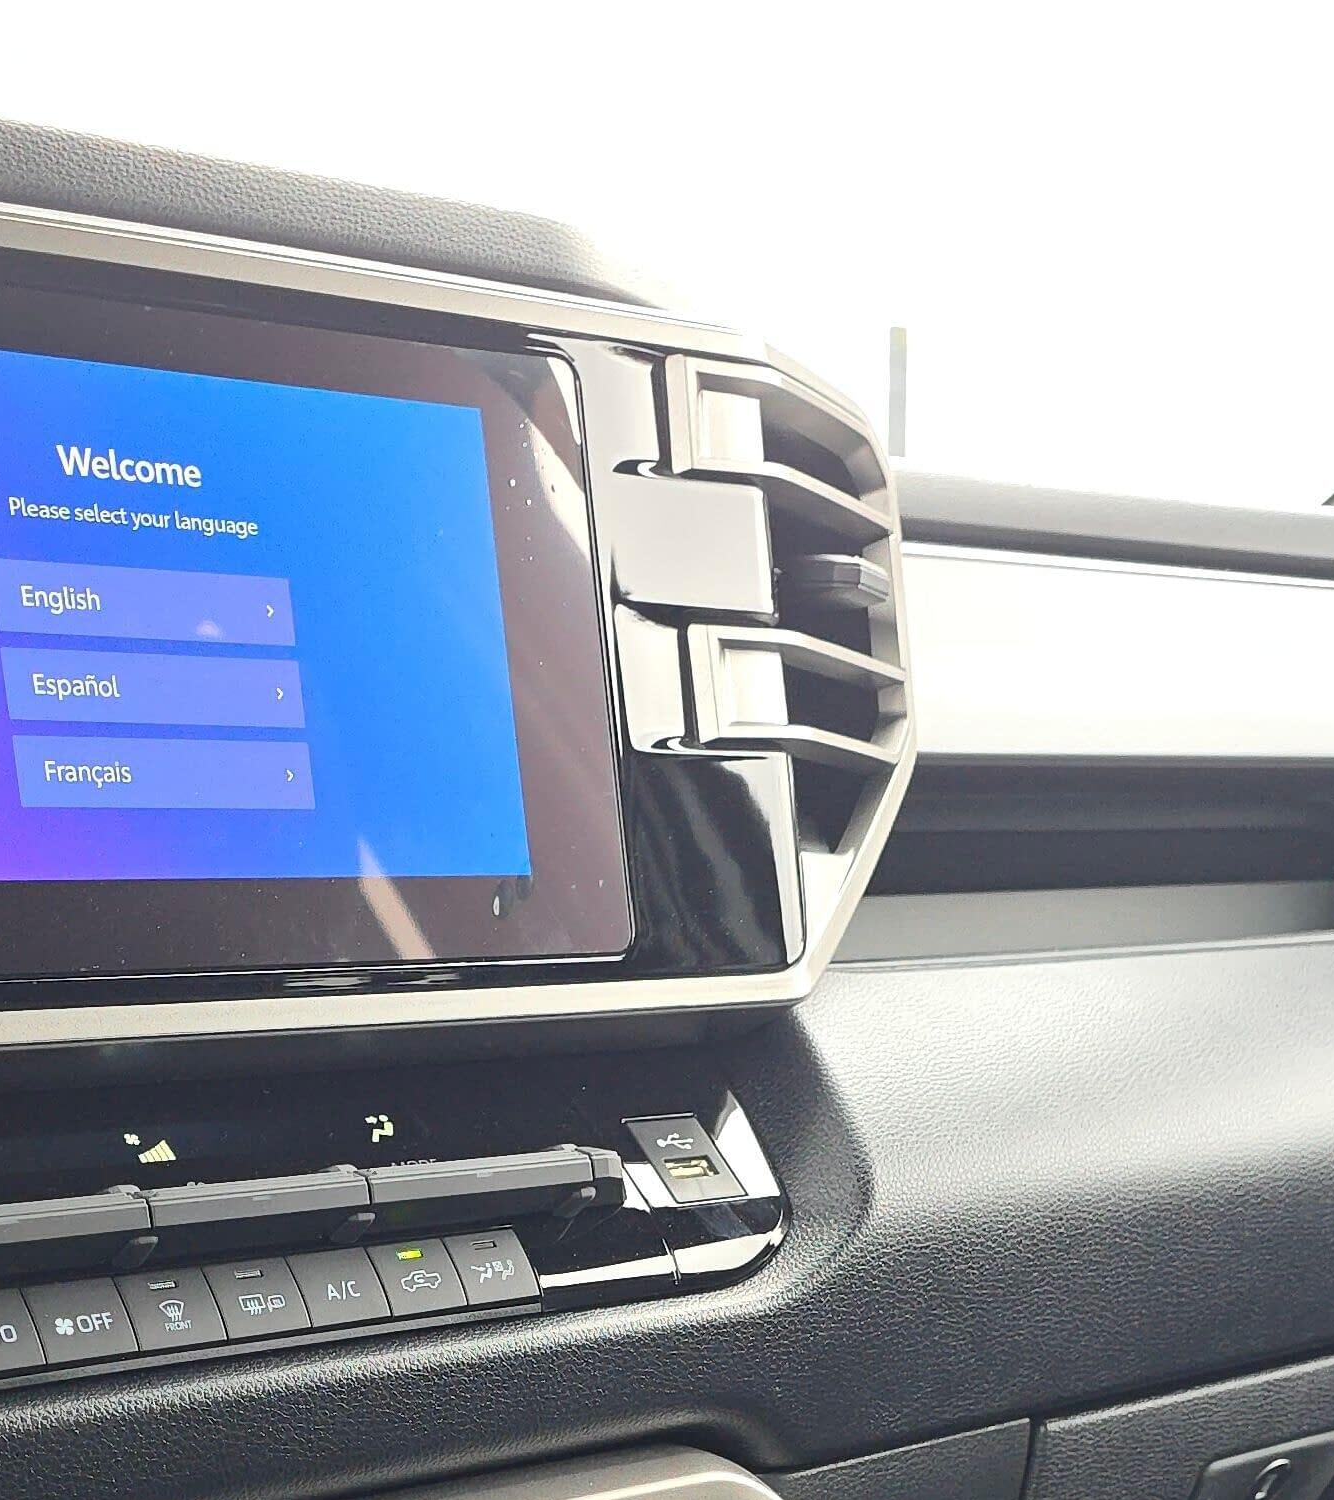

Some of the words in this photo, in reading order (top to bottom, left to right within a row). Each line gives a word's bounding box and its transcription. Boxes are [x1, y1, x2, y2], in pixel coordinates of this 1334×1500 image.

[56, 443, 203, 488] Welcome
[8, 496, 70, 520] Please
[74, 503, 128, 526] select
[130, 511, 171, 531] your
[174, 510, 259, 539] language
[20, 584, 101, 615] English
[32, 672, 121, 701] Español
[44, 759, 132, 788] Français
[327, 1280, 361, 1301] A/C
[76, 1311, 114, 1333] OFF
[163, 1319, 193, 1333] FRONT
